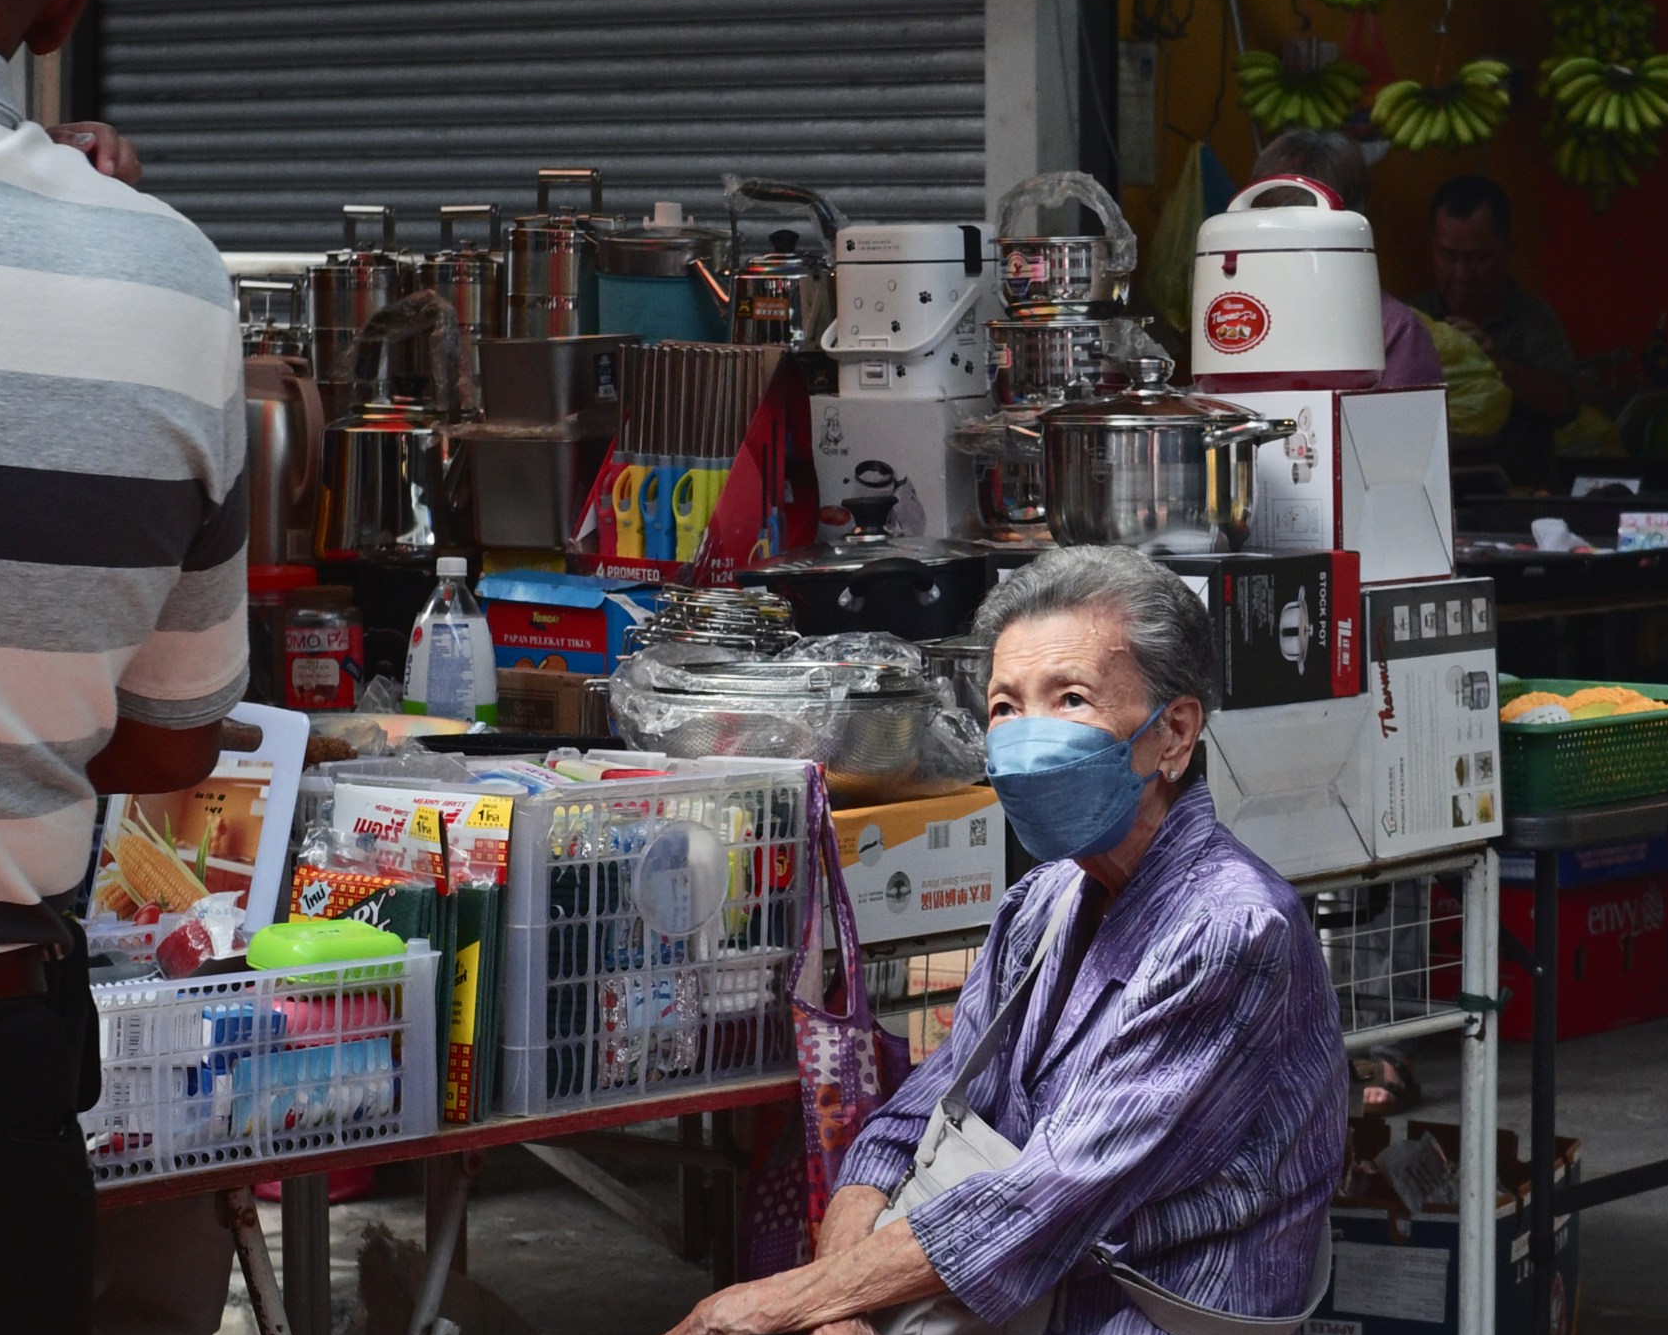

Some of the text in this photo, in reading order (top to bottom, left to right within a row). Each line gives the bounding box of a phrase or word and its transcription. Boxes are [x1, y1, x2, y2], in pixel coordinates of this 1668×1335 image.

[606, 564, 660, 582] PROMETEO
[1317, 571, 1327, 648] STOCK POT
[503, 633, 592, 649] PAPAN PELEKAT TIKUS
[403, 653, 414, 696] PLUS
